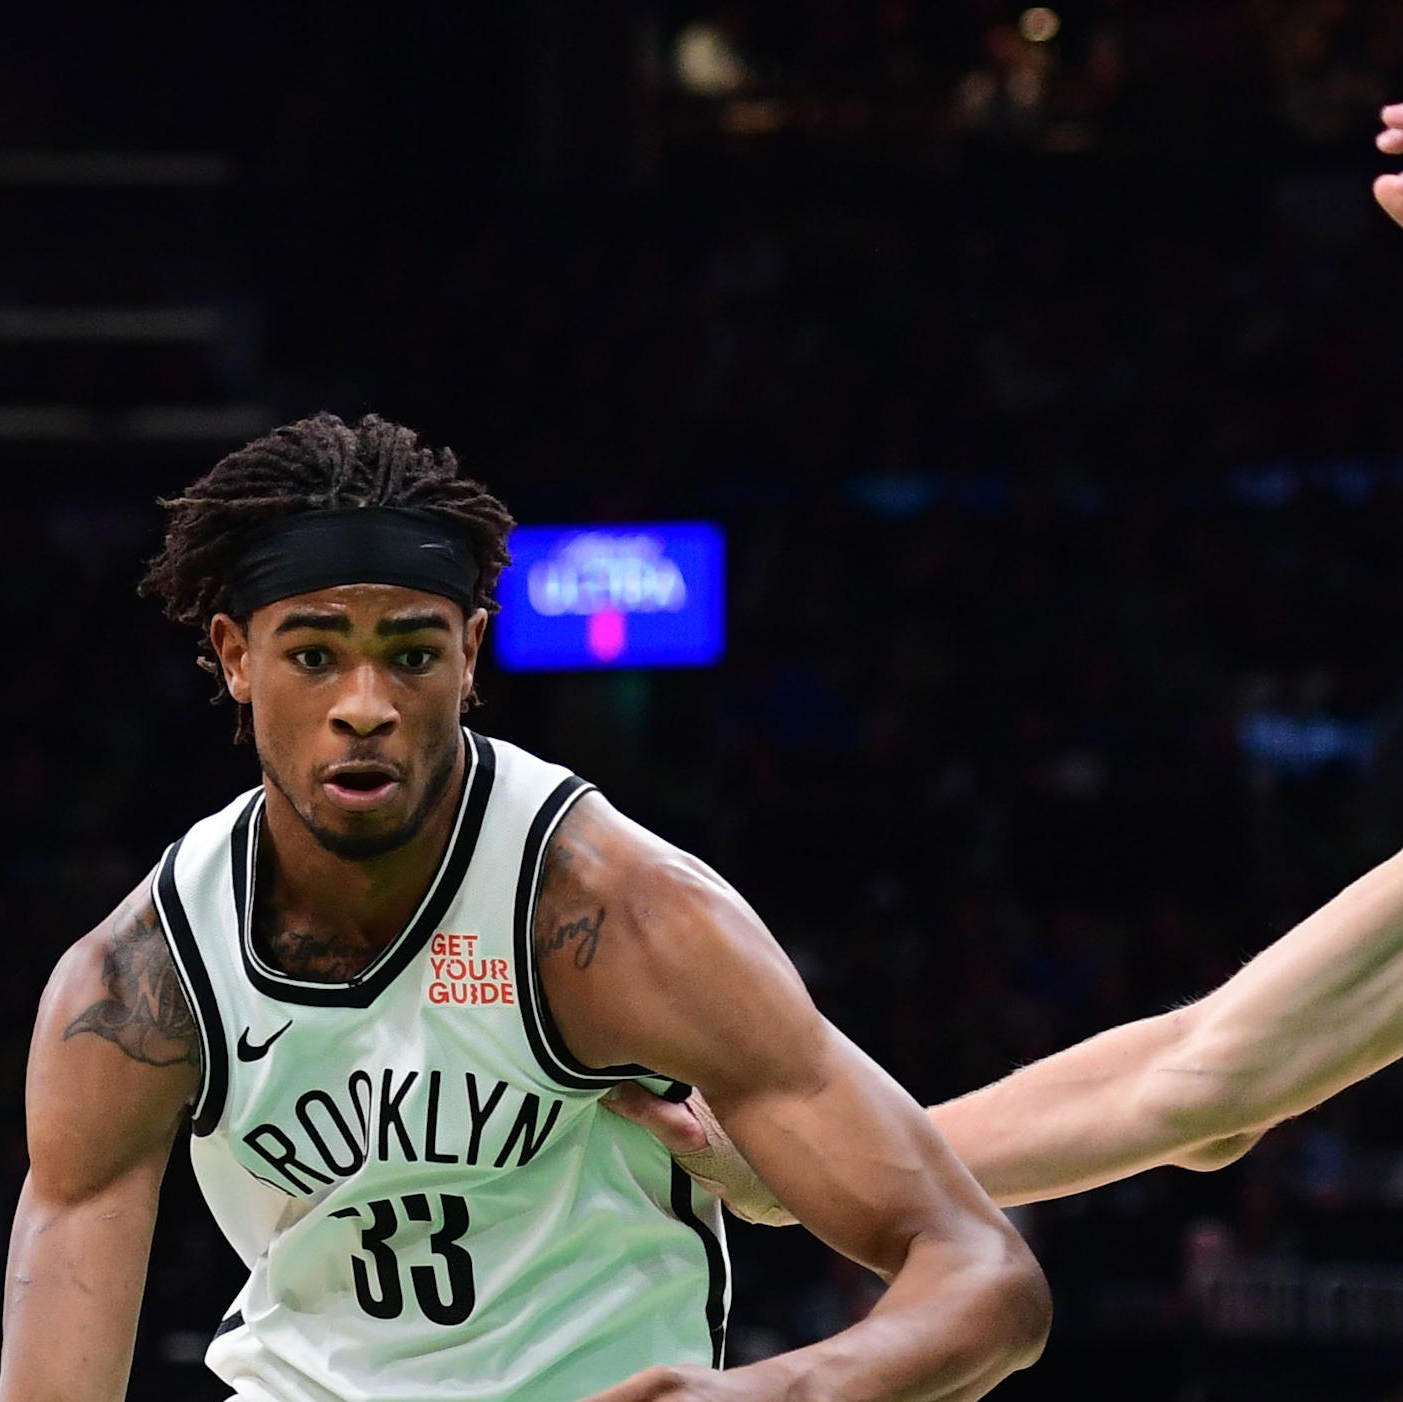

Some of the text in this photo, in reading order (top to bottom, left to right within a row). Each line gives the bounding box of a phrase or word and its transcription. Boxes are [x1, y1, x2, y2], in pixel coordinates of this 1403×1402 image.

[431, 933, 478, 957] GET
[430, 957, 509, 981] YOUR
[428, 981, 515, 1005] GUIDE
[241, 1068, 563, 1198] ROOKLYN
[327, 1193, 476, 1326] 33
